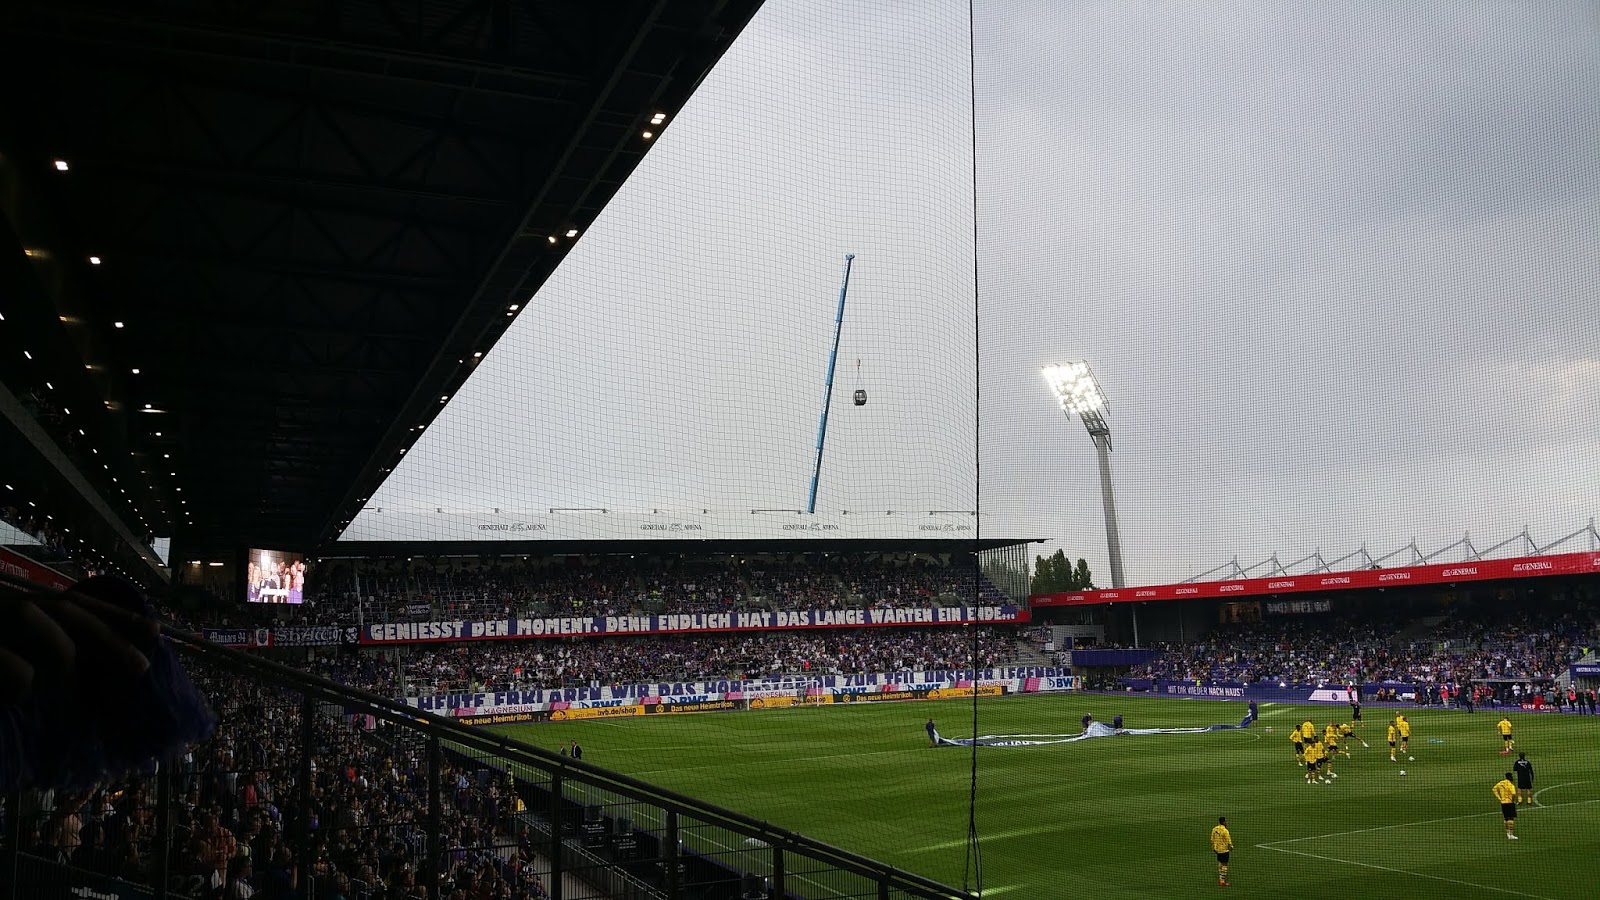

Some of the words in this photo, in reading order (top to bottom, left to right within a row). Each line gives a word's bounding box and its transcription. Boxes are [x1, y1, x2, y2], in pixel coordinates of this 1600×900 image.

[1521, 562, 1552, 570] GENERALI
[1450, 567, 1477, 576] GENERALI
[370, 621, 463, 641] GENIESST
[471, 620, 509, 637] DEN
[516, 617, 599, 635] MOMENT,
[658, 613, 731, 630] ENDLICH
[738, 612, 771, 627] HAT
[777, 611, 809, 627] DAS
[815, 609, 865, 625] LANGE
[870, 608, 933, 623] WARTEN
[938, 607, 962, 622] EIN
[418, 693, 485, 710] HEUTE
[611, 684, 650, 698] WIR
[658, 682, 696, 696] DAS
[843, 673, 877, 687] ZUM
[925, 668, 993, 682] UNSERER
[1167, 685, 1177, 694] MIT
[1177, 685, 1187, 694] DIR
[1187, 686, 1208, 695] WIEDER
[1208, 687, 1225, 696] NACH
[856, 694, 867, 702] Das
[868, 693, 881, 701] neue
[483, 705, 533, 714] MAGNESIUM
[597, 707, 637, 717] bvb.de/shop
[671, 704, 683, 712] Das
[684, 703, 699, 712] neue
[474, 715, 492, 725] neue
